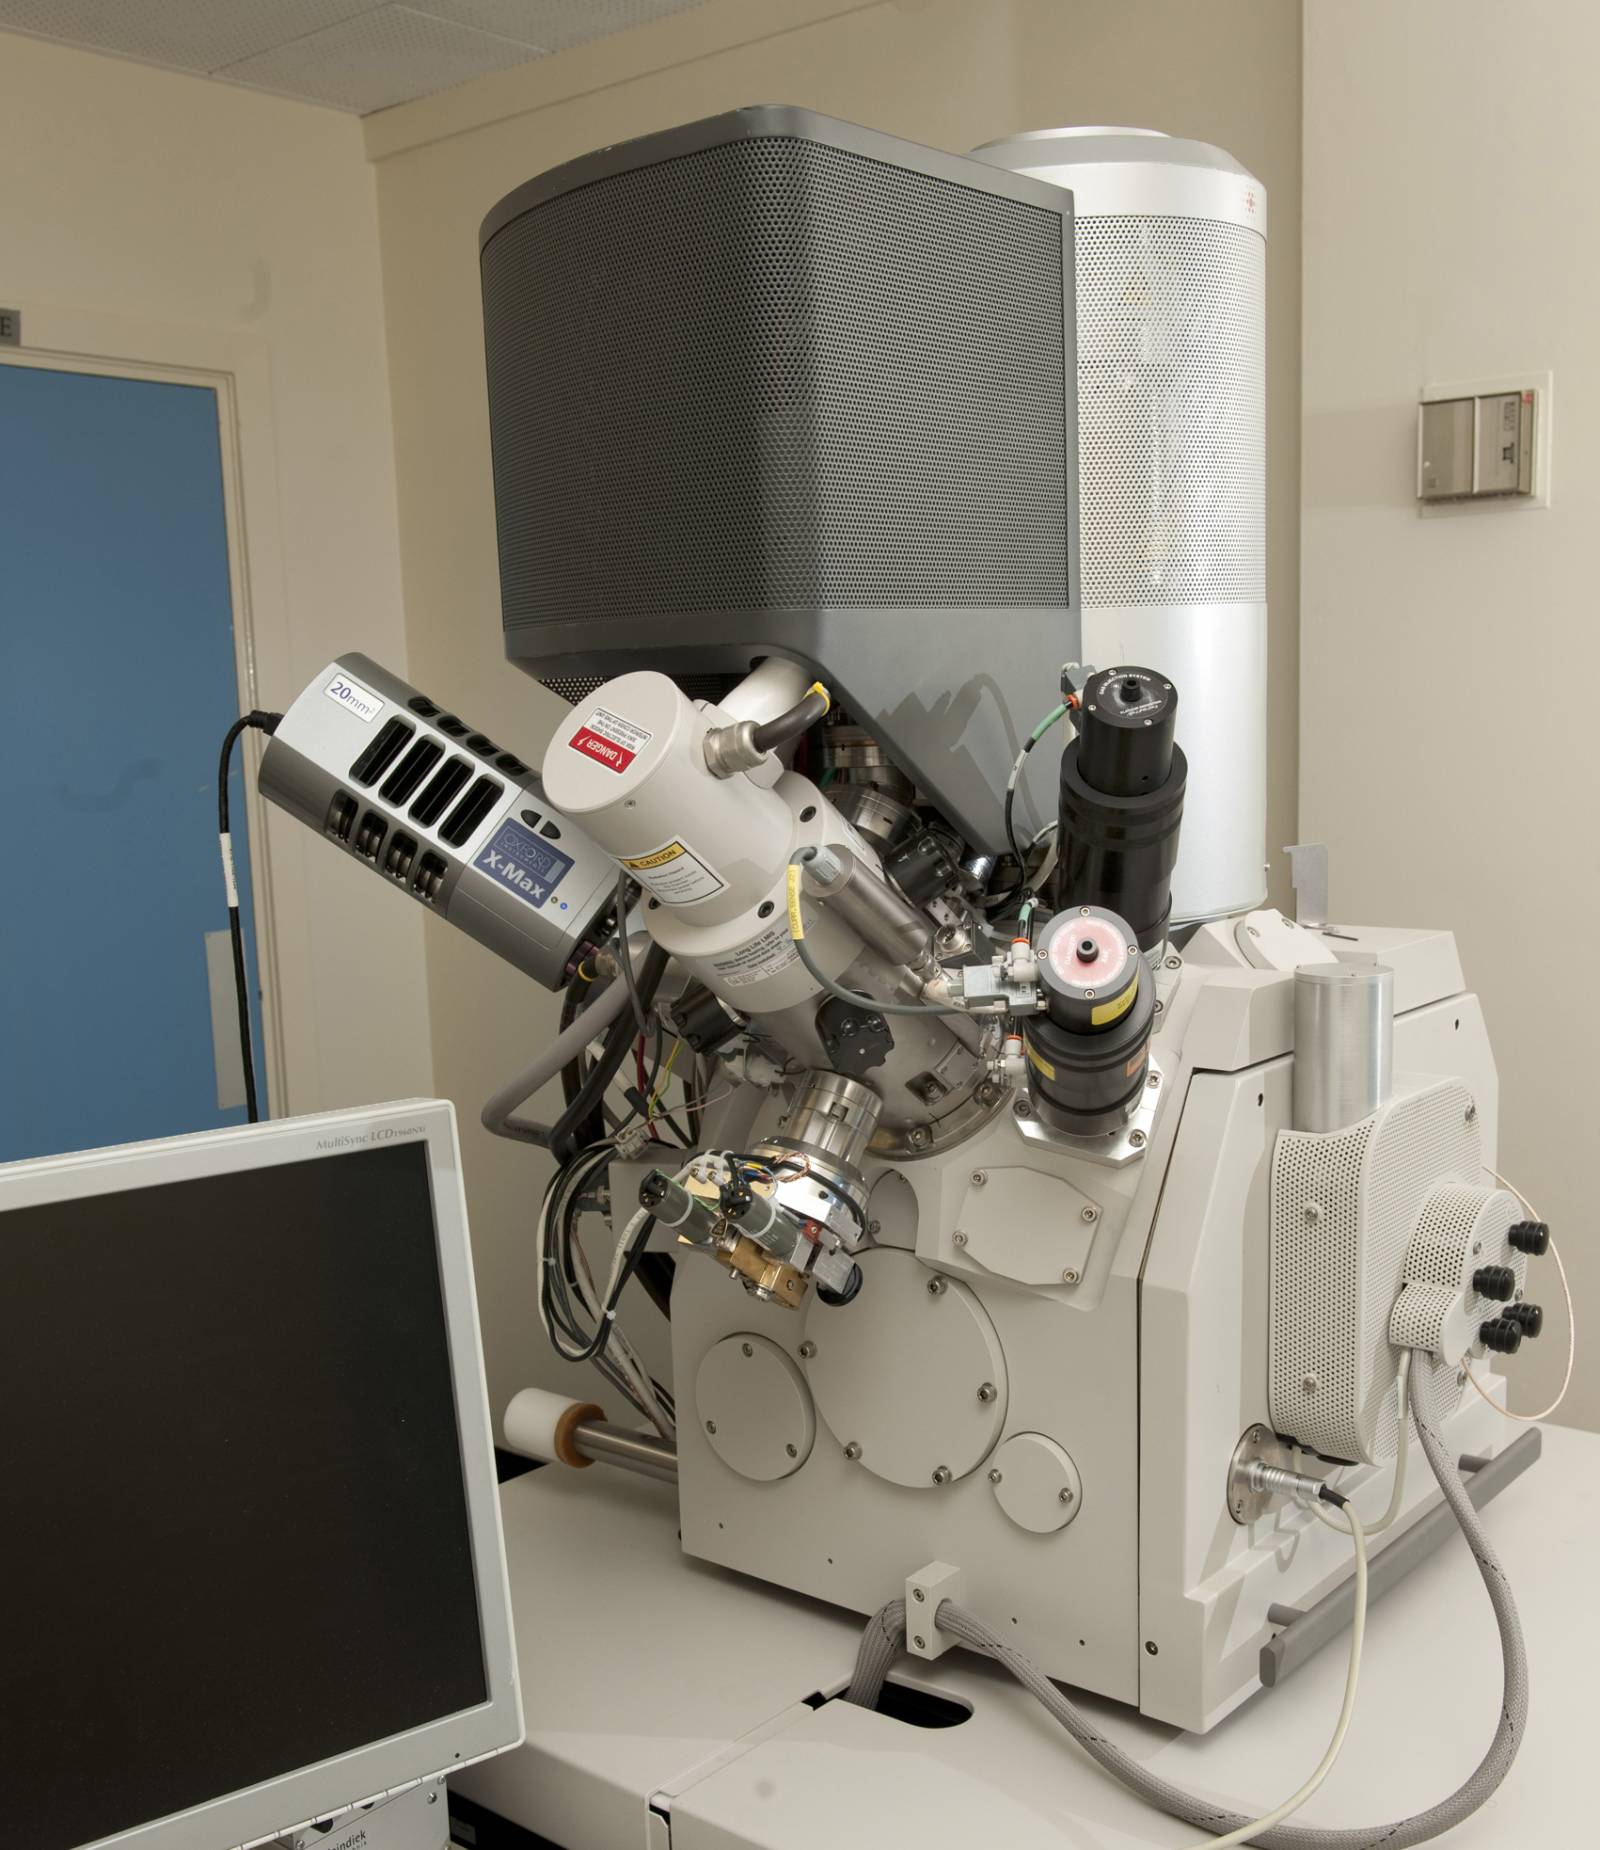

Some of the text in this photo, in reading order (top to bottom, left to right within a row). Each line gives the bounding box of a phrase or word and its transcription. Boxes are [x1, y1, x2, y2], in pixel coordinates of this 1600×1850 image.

[587, 739, 618, 760] DANGER
[504, 833, 552, 869] OXFORD
[640, 849, 676, 867] CAUTION
[483, 849, 546, 899] X-Max
[735, 947, 751, 957] Long
[750, 941, 761, 949] Life
[316, 1135, 369, 1150] MultiSync
